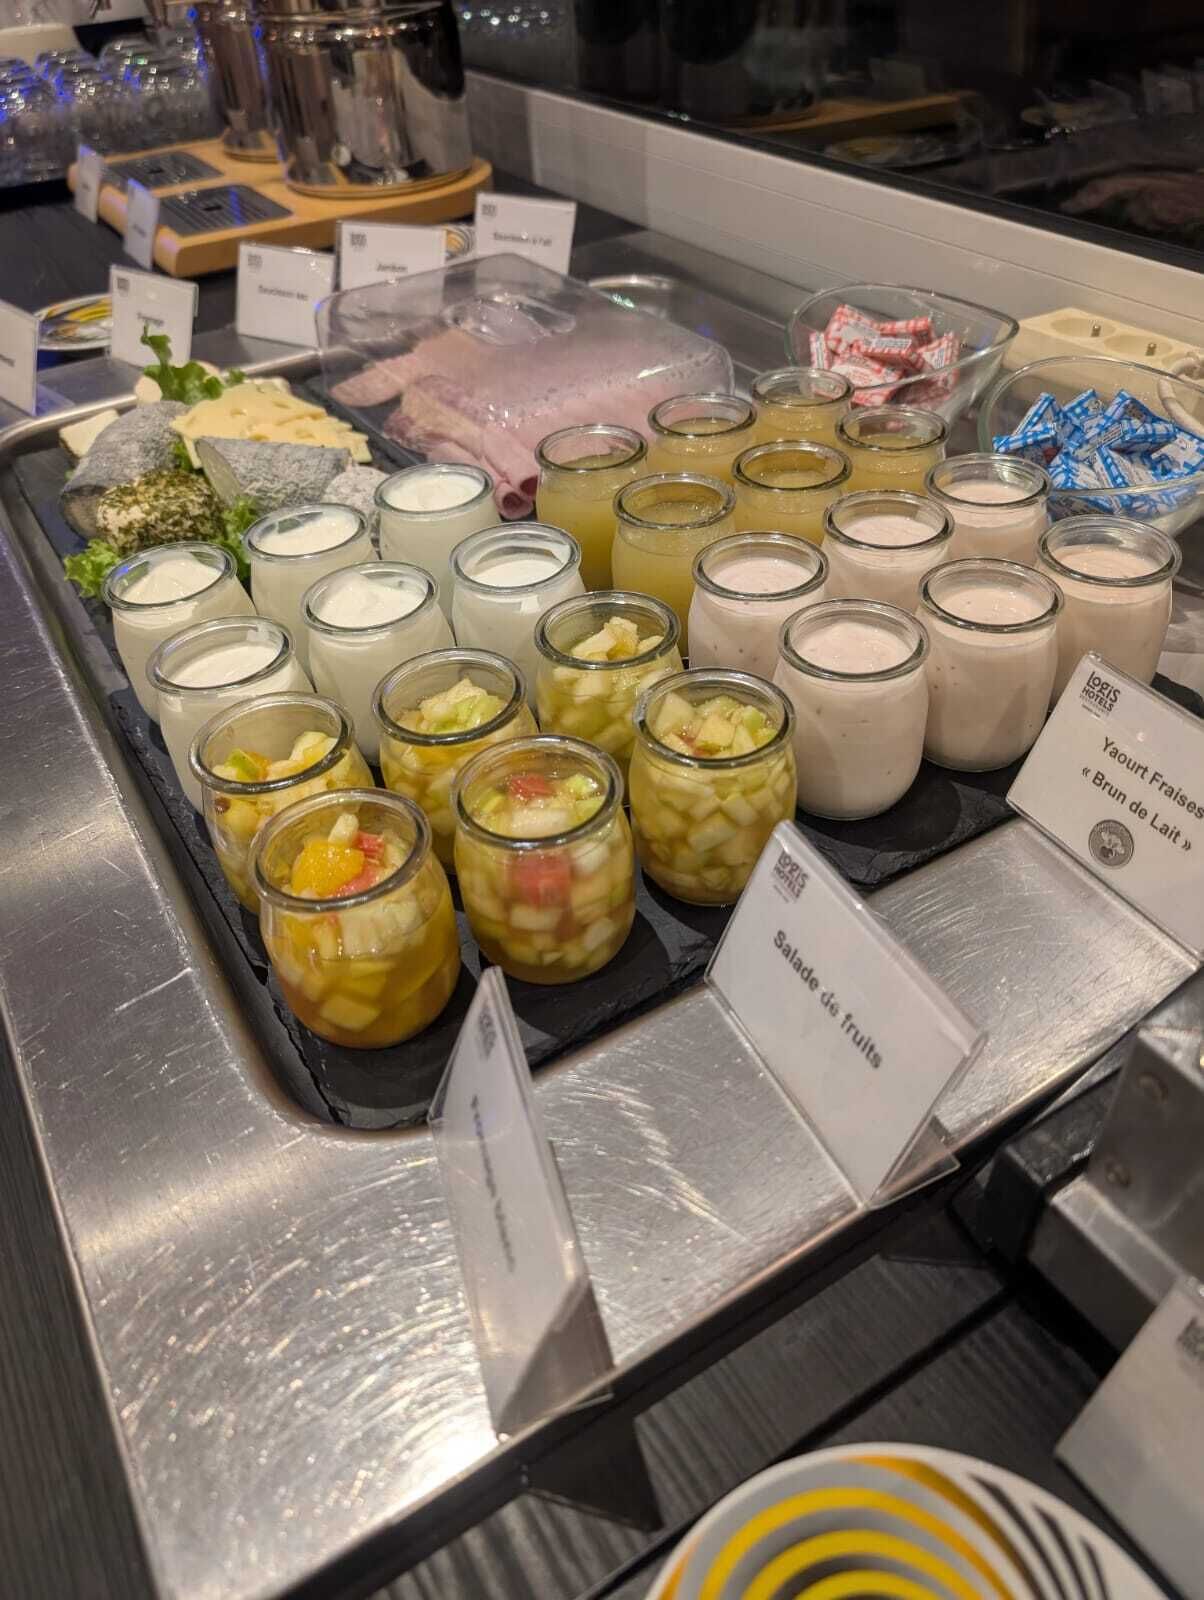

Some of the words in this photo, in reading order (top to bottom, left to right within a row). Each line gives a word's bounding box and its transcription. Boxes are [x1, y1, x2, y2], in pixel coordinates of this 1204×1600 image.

[1081, 686, 1114, 712] HOTELS
[1092, 771, 1127, 804] Brun
[1129, 801, 1148, 820] de
[1150, 813, 1181, 844] Lait
[1102, 736, 1149, 780] Yaourt
[1148, 771, 1204, 819] Fraises
[774, 929, 819, 991] Salade
[820, 991, 839, 1017] de
[840, 1013, 883, 1069] fruits
